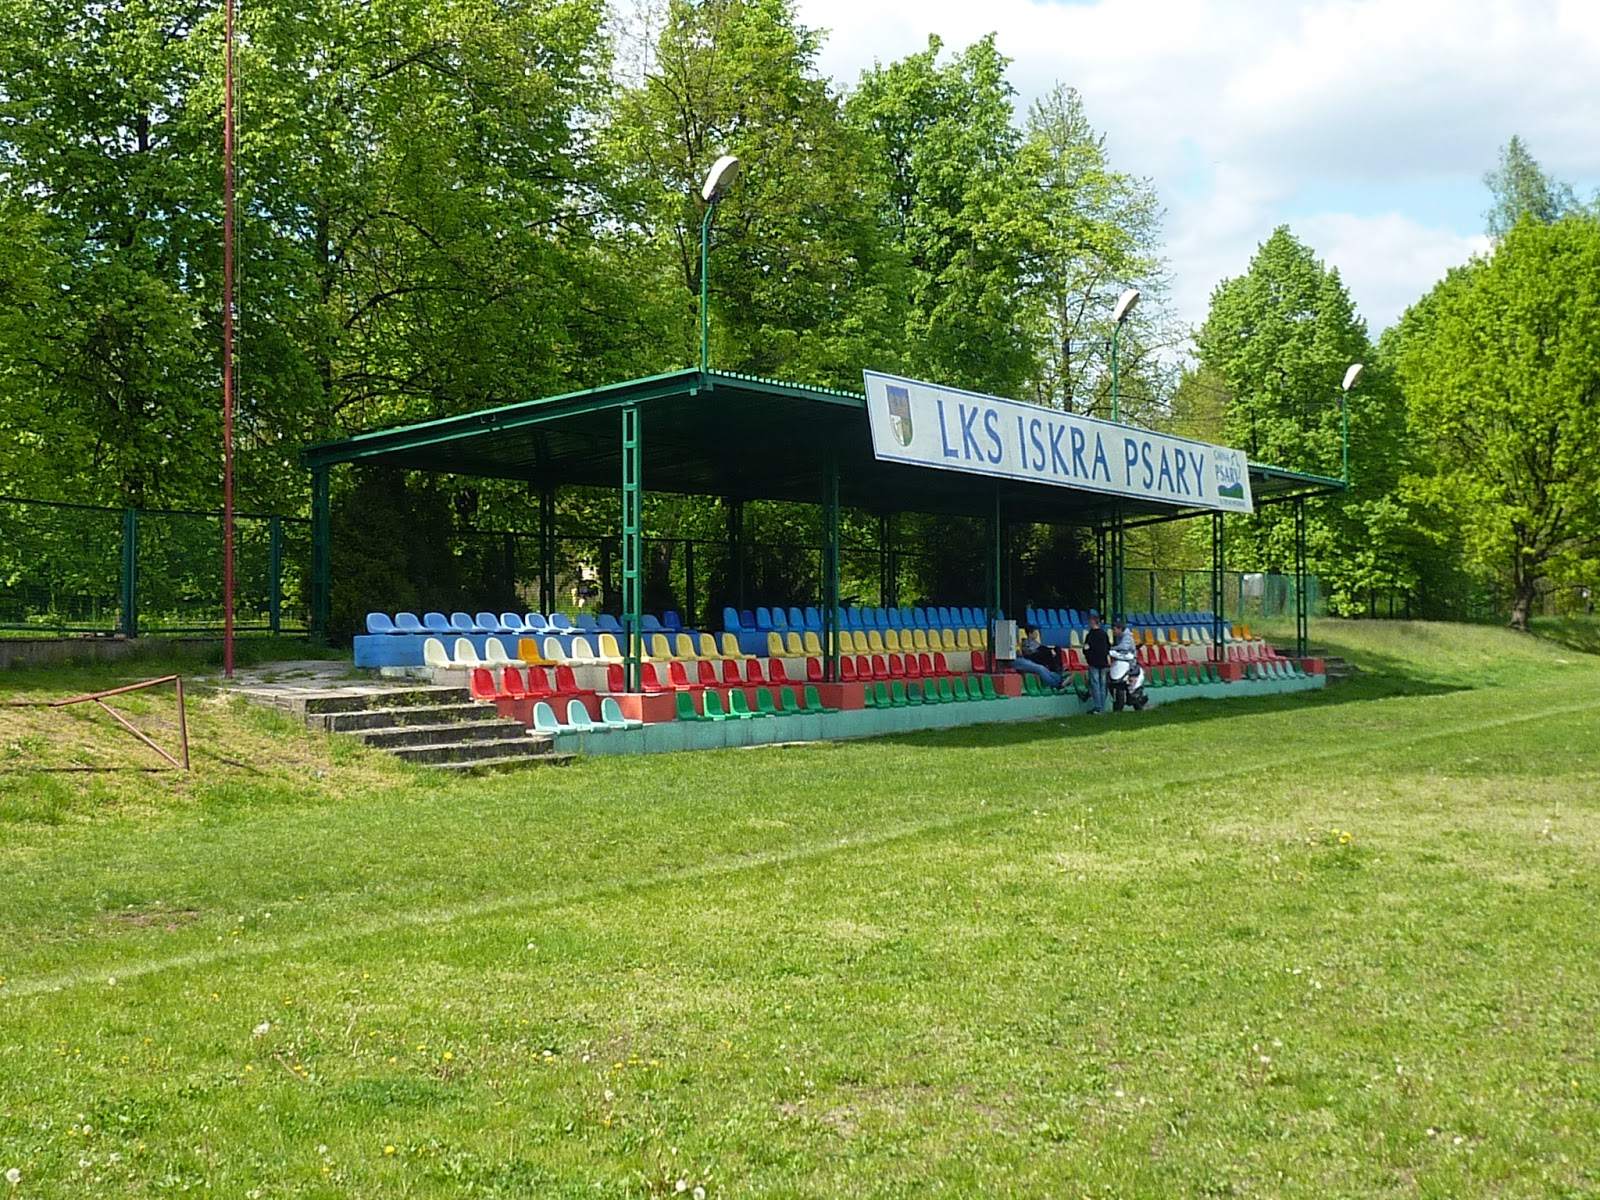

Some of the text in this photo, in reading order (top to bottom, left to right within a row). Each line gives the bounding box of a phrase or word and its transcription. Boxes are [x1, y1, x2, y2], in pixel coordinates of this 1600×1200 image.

[937, 400, 1204, 497] LKS ISKRA PSARY
